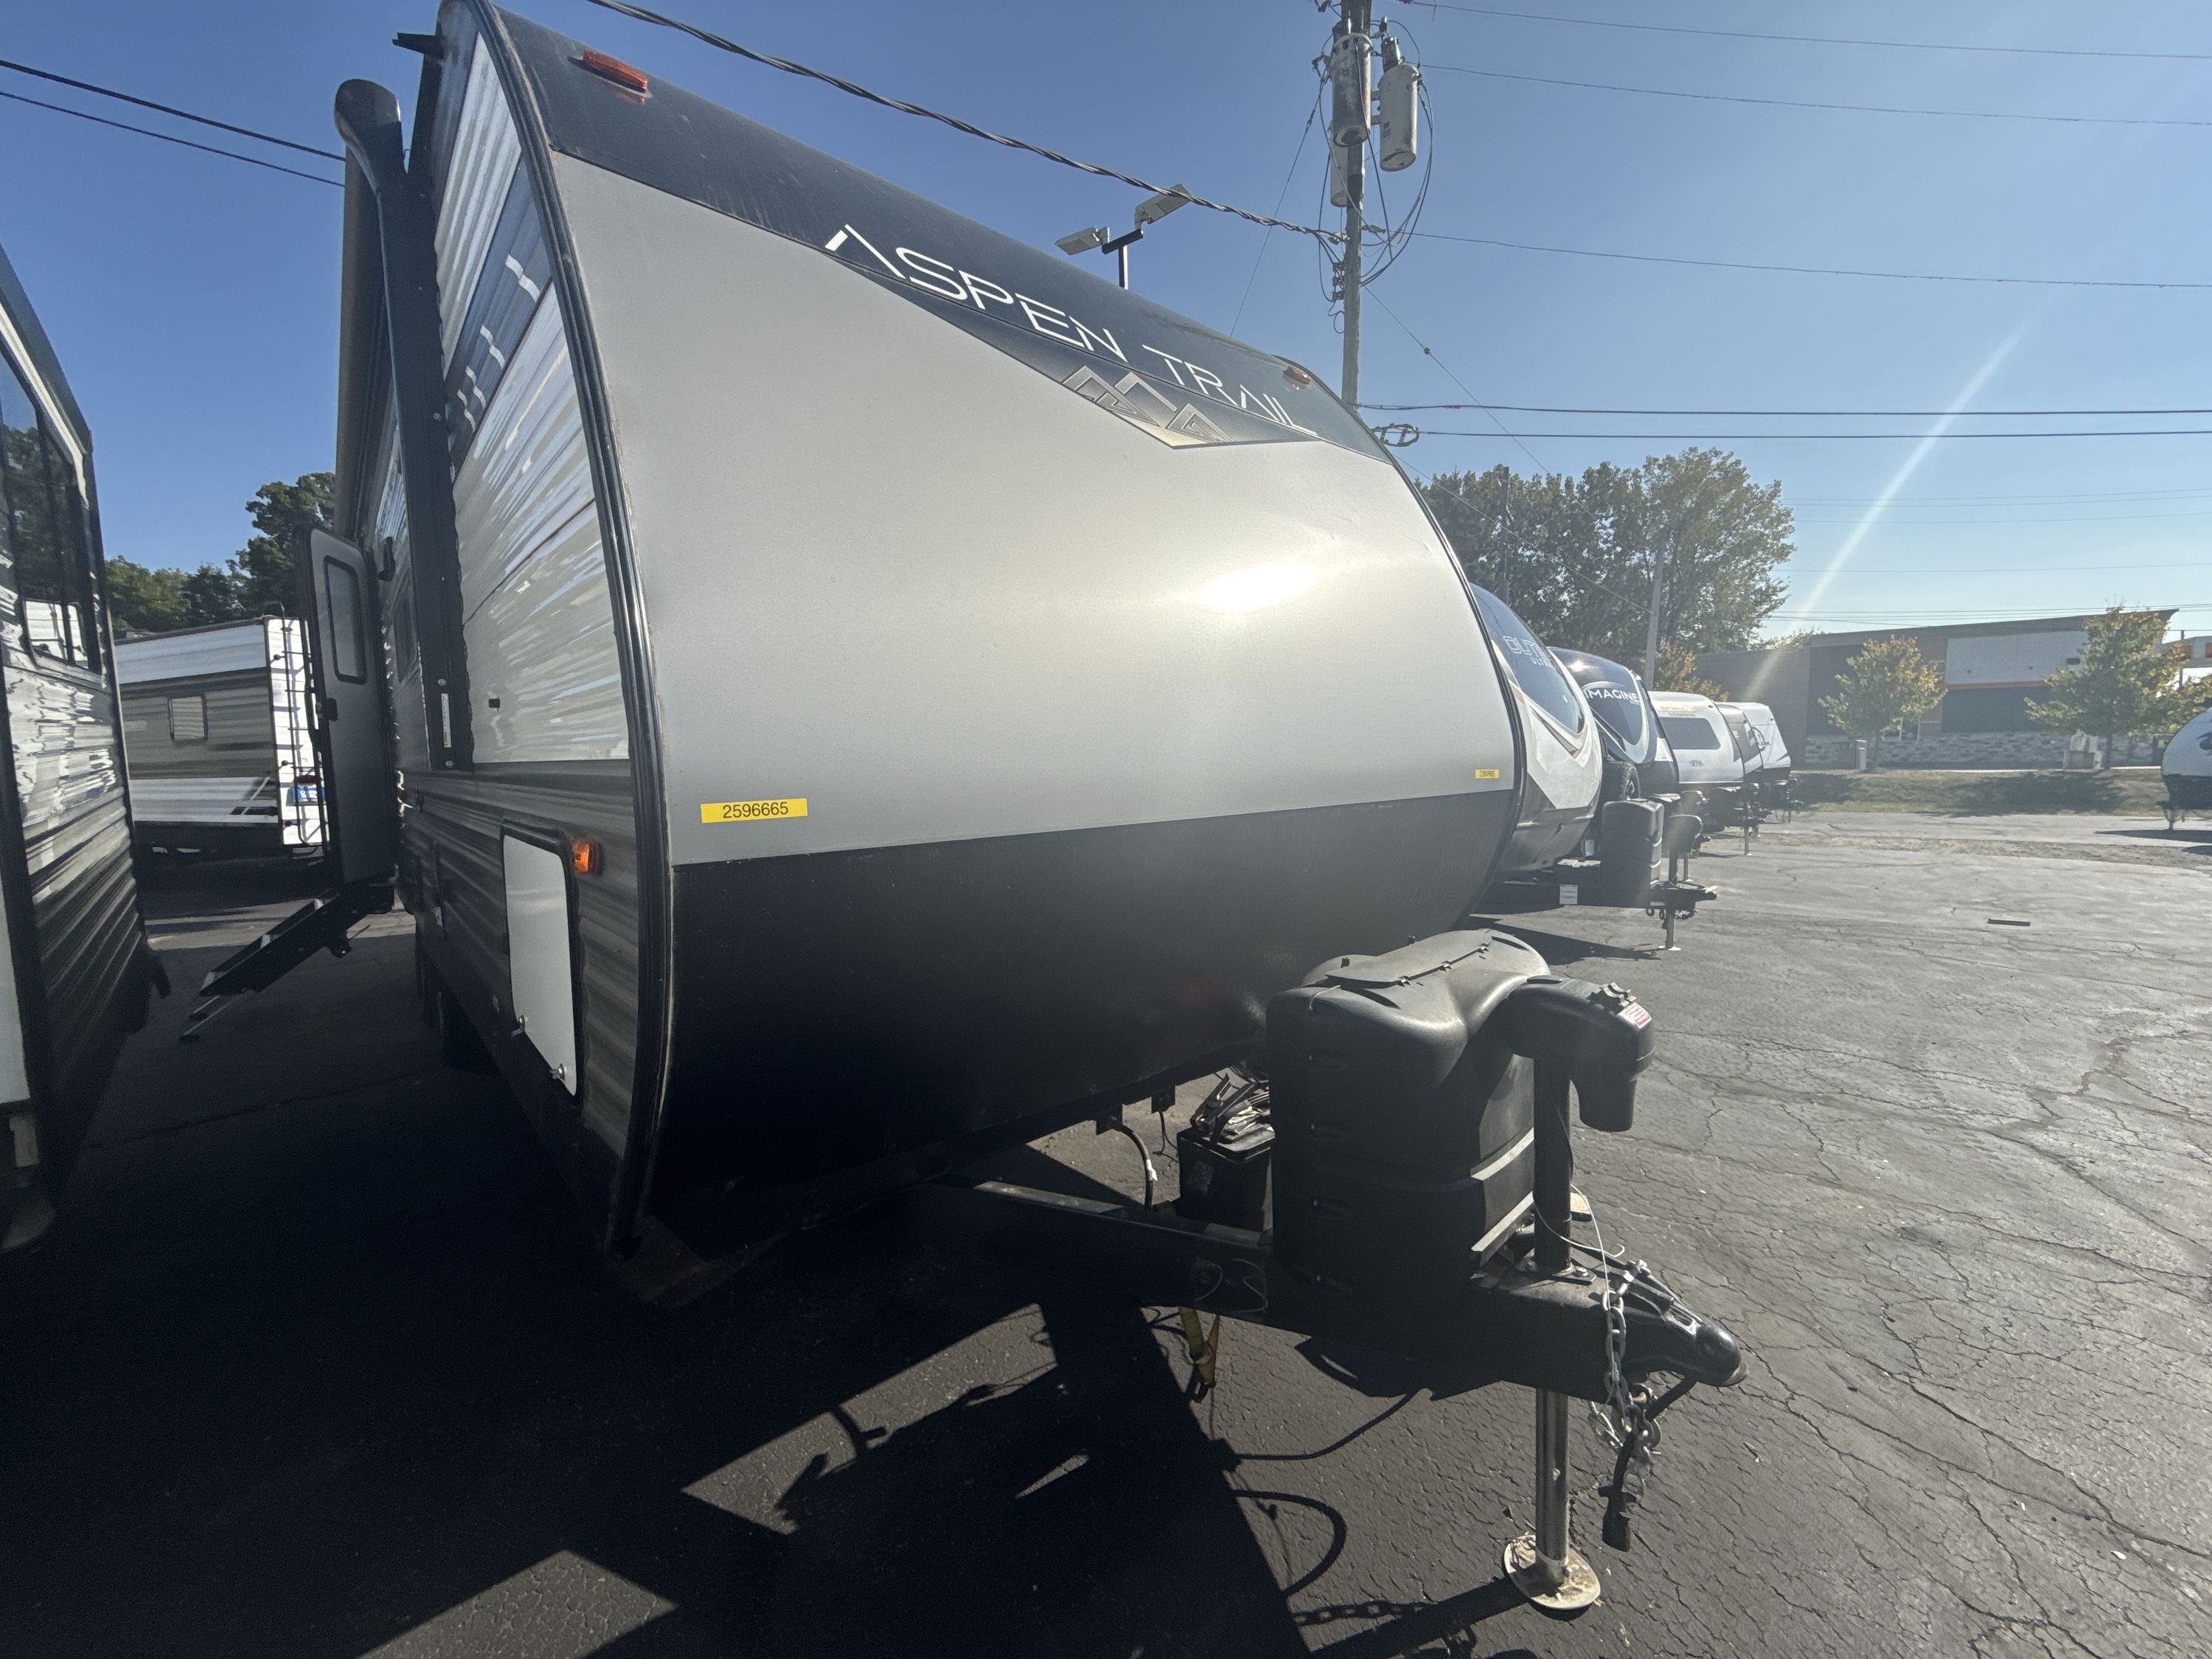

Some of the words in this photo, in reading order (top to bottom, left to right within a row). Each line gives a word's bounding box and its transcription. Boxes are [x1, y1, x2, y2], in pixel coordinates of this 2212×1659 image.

[825, 223, 1128, 363] ASPEN
[1143, 344, 1318, 437] TRAIL
[1583, 689, 1641, 703] IMAGINE
[723, 801, 789, 818] 2596665
